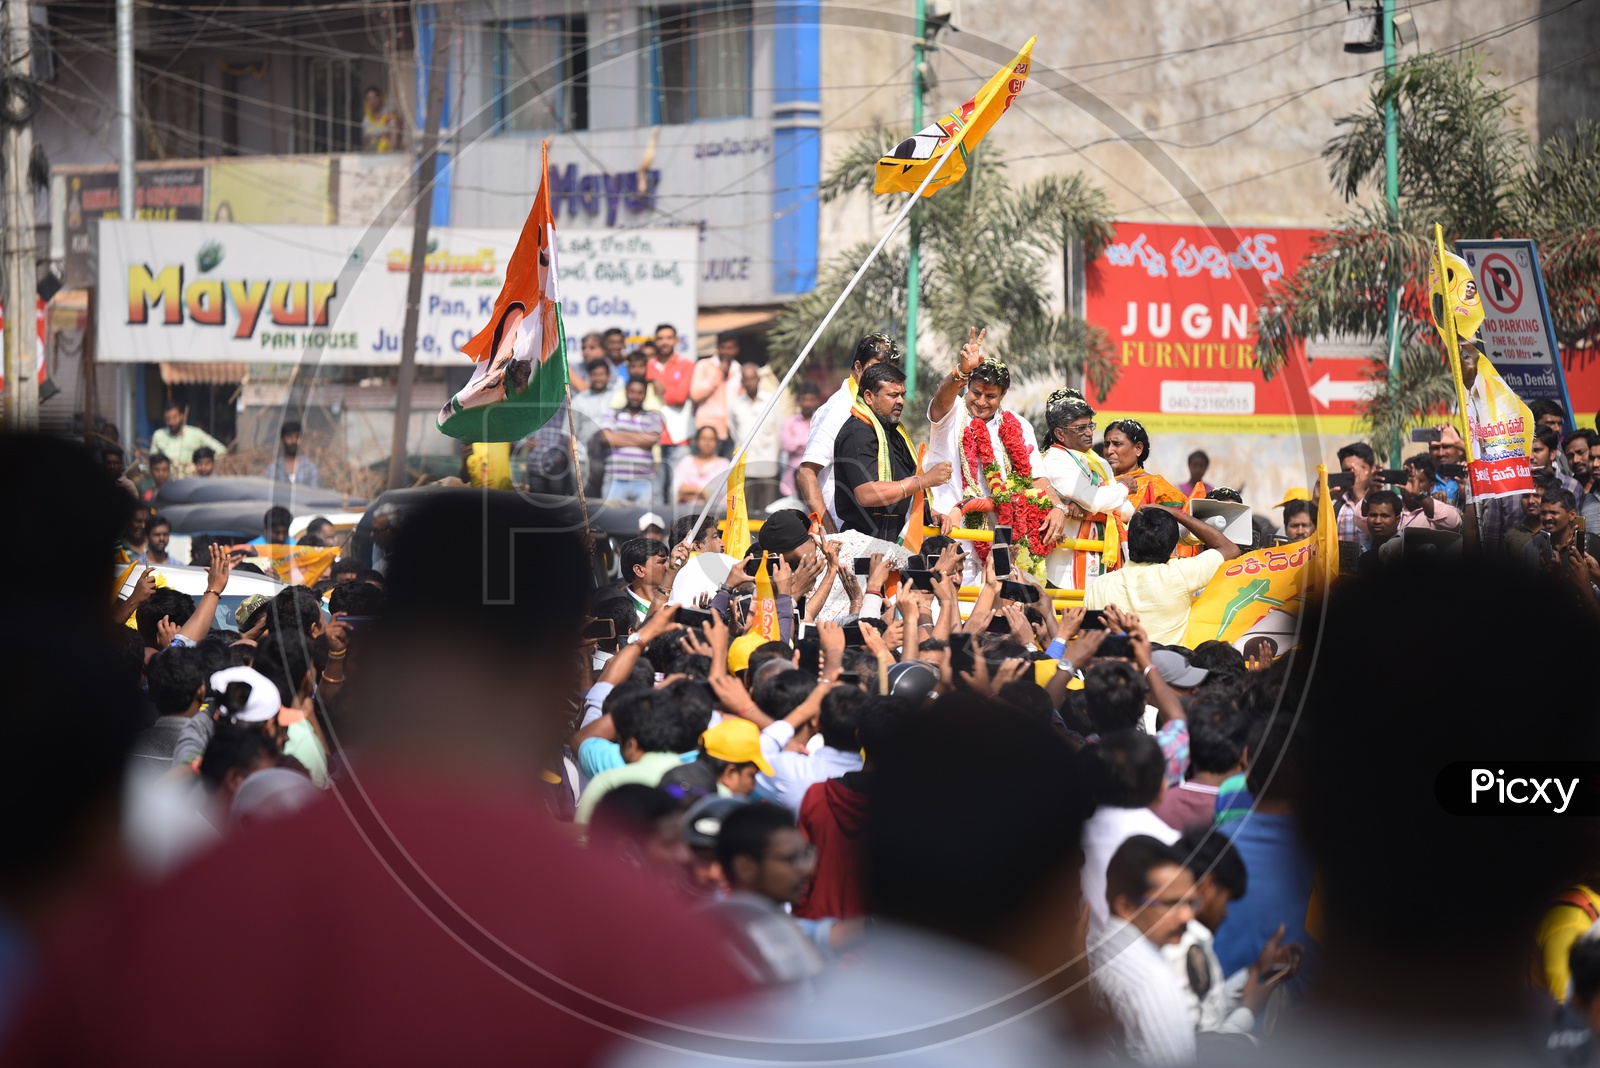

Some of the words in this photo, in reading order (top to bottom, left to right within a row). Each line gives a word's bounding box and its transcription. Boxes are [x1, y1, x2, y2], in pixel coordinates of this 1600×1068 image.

[126, 264, 337, 339] Mayur
[428, 294, 471, 320] Pan,
[586, 295, 636, 320] Gola,
[1484, 319, 1497, 333] NO
[1499, 319, 1539, 333] PARKING
[261, 332, 296, 349] PAN
[301, 333, 358, 349] HOUSE
[1492, 336, 1506, 346] FINE
[1508, 336, 1517, 346] Rs.
[1518, 336, 1537, 346] 1000/-
[1504, 349, 1515, 359] 100
[1516, 349, 1531, 359] Mtrs
[1523, 372, 1556, 386] Dental
